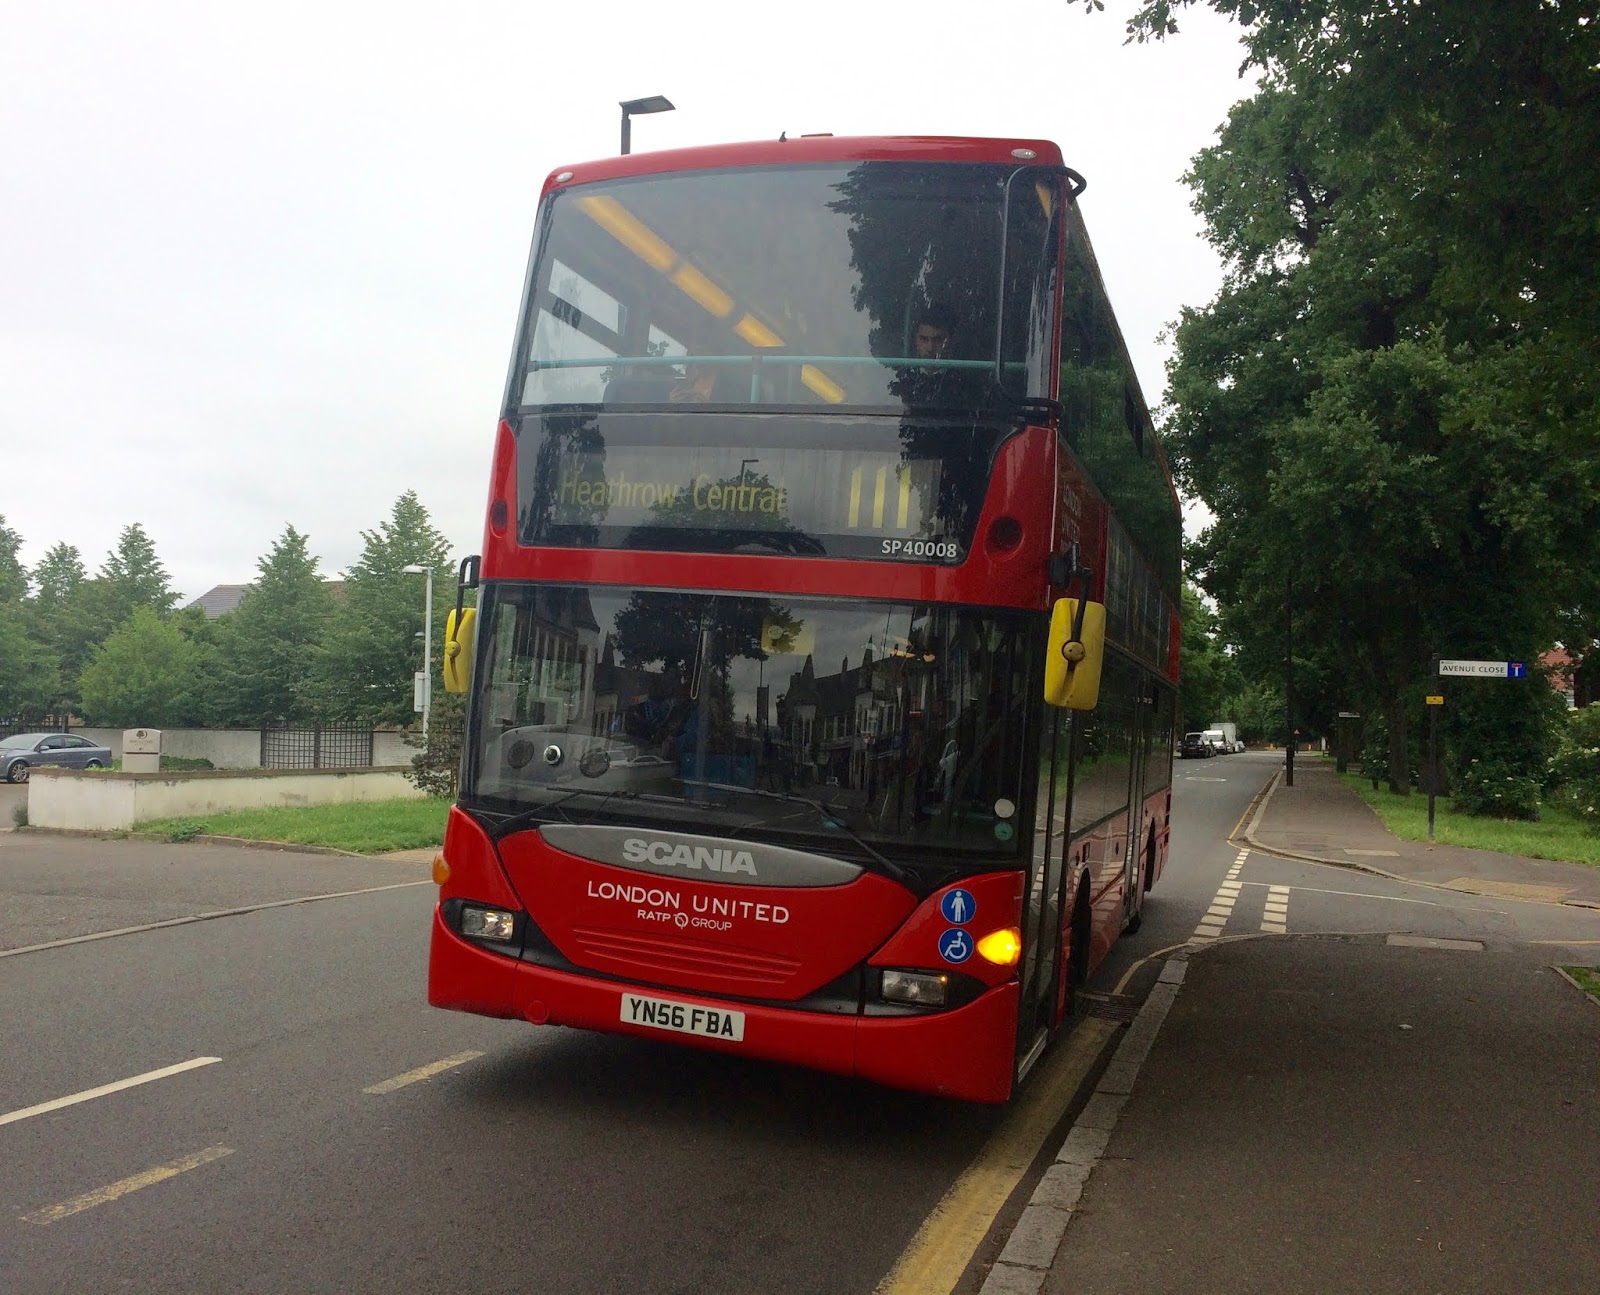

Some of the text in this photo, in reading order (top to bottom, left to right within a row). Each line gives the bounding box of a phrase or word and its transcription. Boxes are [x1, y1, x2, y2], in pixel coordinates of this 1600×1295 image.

[560, 471, 785, 514] Heathrow Central
[847, 464, 912, 529] 111
[881, 539, 957, 558] SP40008
[1442, 664, 1505, 674] AVENUE CLOSE
[623, 838, 758, 876] SCANIA
[587, 880, 789, 924] LONDON UNITED
[637, 909, 732, 931] RATP GROUP
[630, 998, 733, 1037] YN56 FBA
